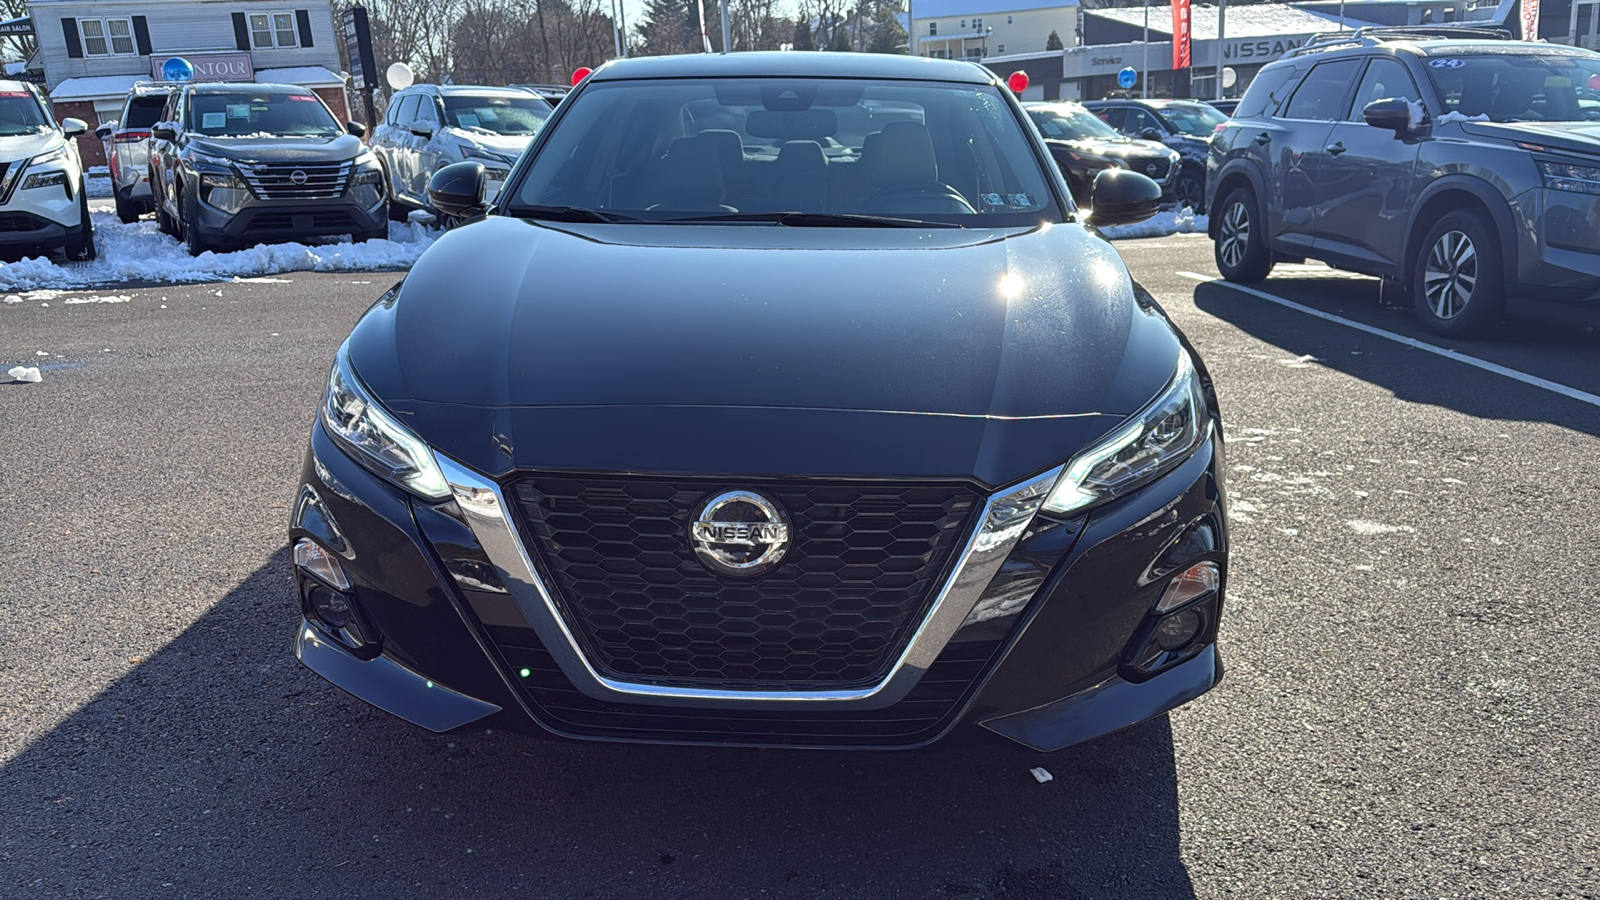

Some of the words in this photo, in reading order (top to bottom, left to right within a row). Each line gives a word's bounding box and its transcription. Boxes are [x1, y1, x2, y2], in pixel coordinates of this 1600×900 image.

[1092, 56, 1122, 66] Service
[1434, 59, 1460, 68] 24
[703, 526, 777, 539] NISSAN
